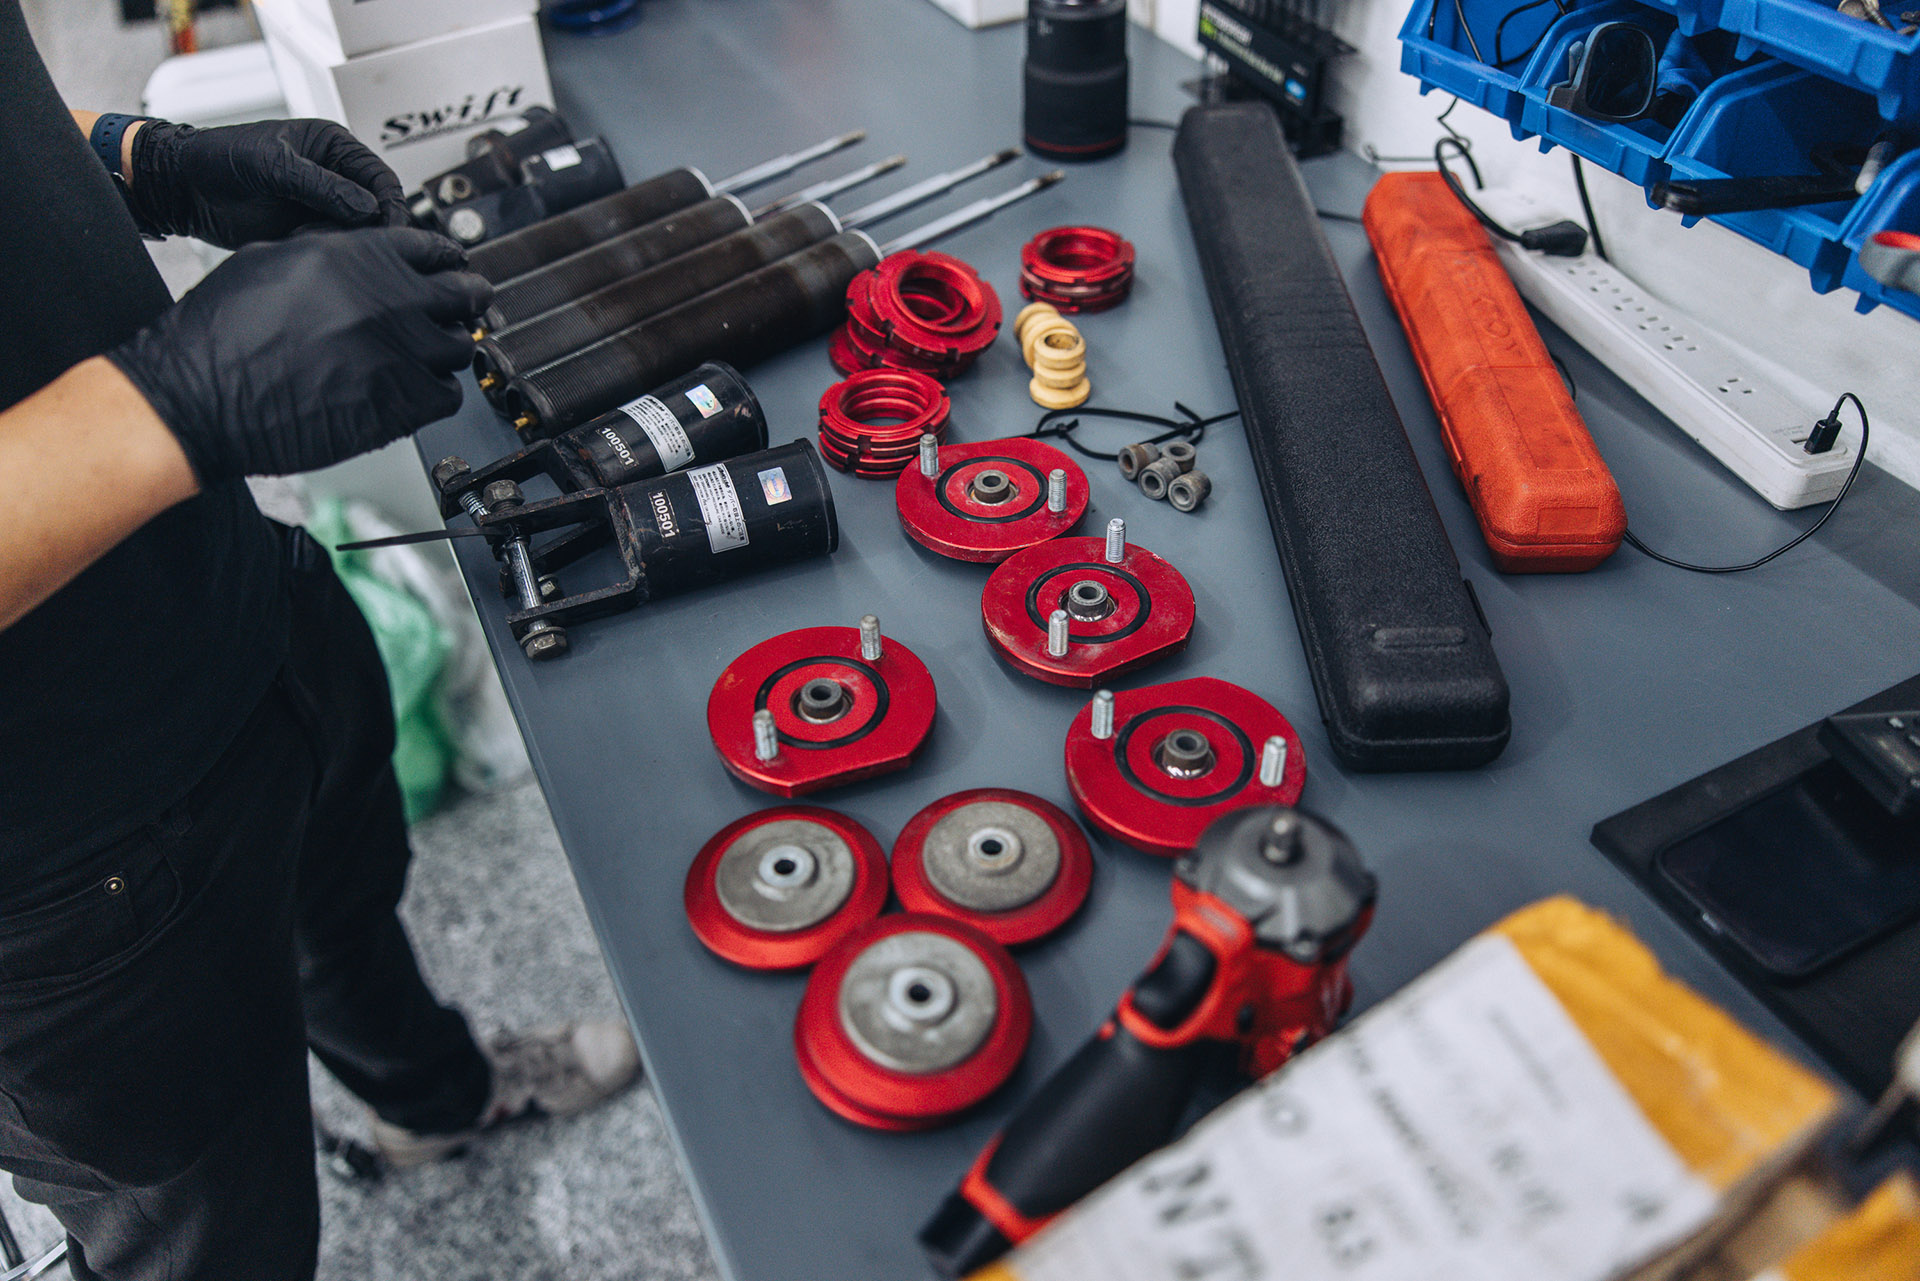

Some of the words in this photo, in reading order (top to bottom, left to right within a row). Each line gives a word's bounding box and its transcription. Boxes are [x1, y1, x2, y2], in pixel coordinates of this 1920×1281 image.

[380, 84, 524, 142] Swift
[602, 427, 634, 465] 100501
[652, 491, 676, 538] 100501
